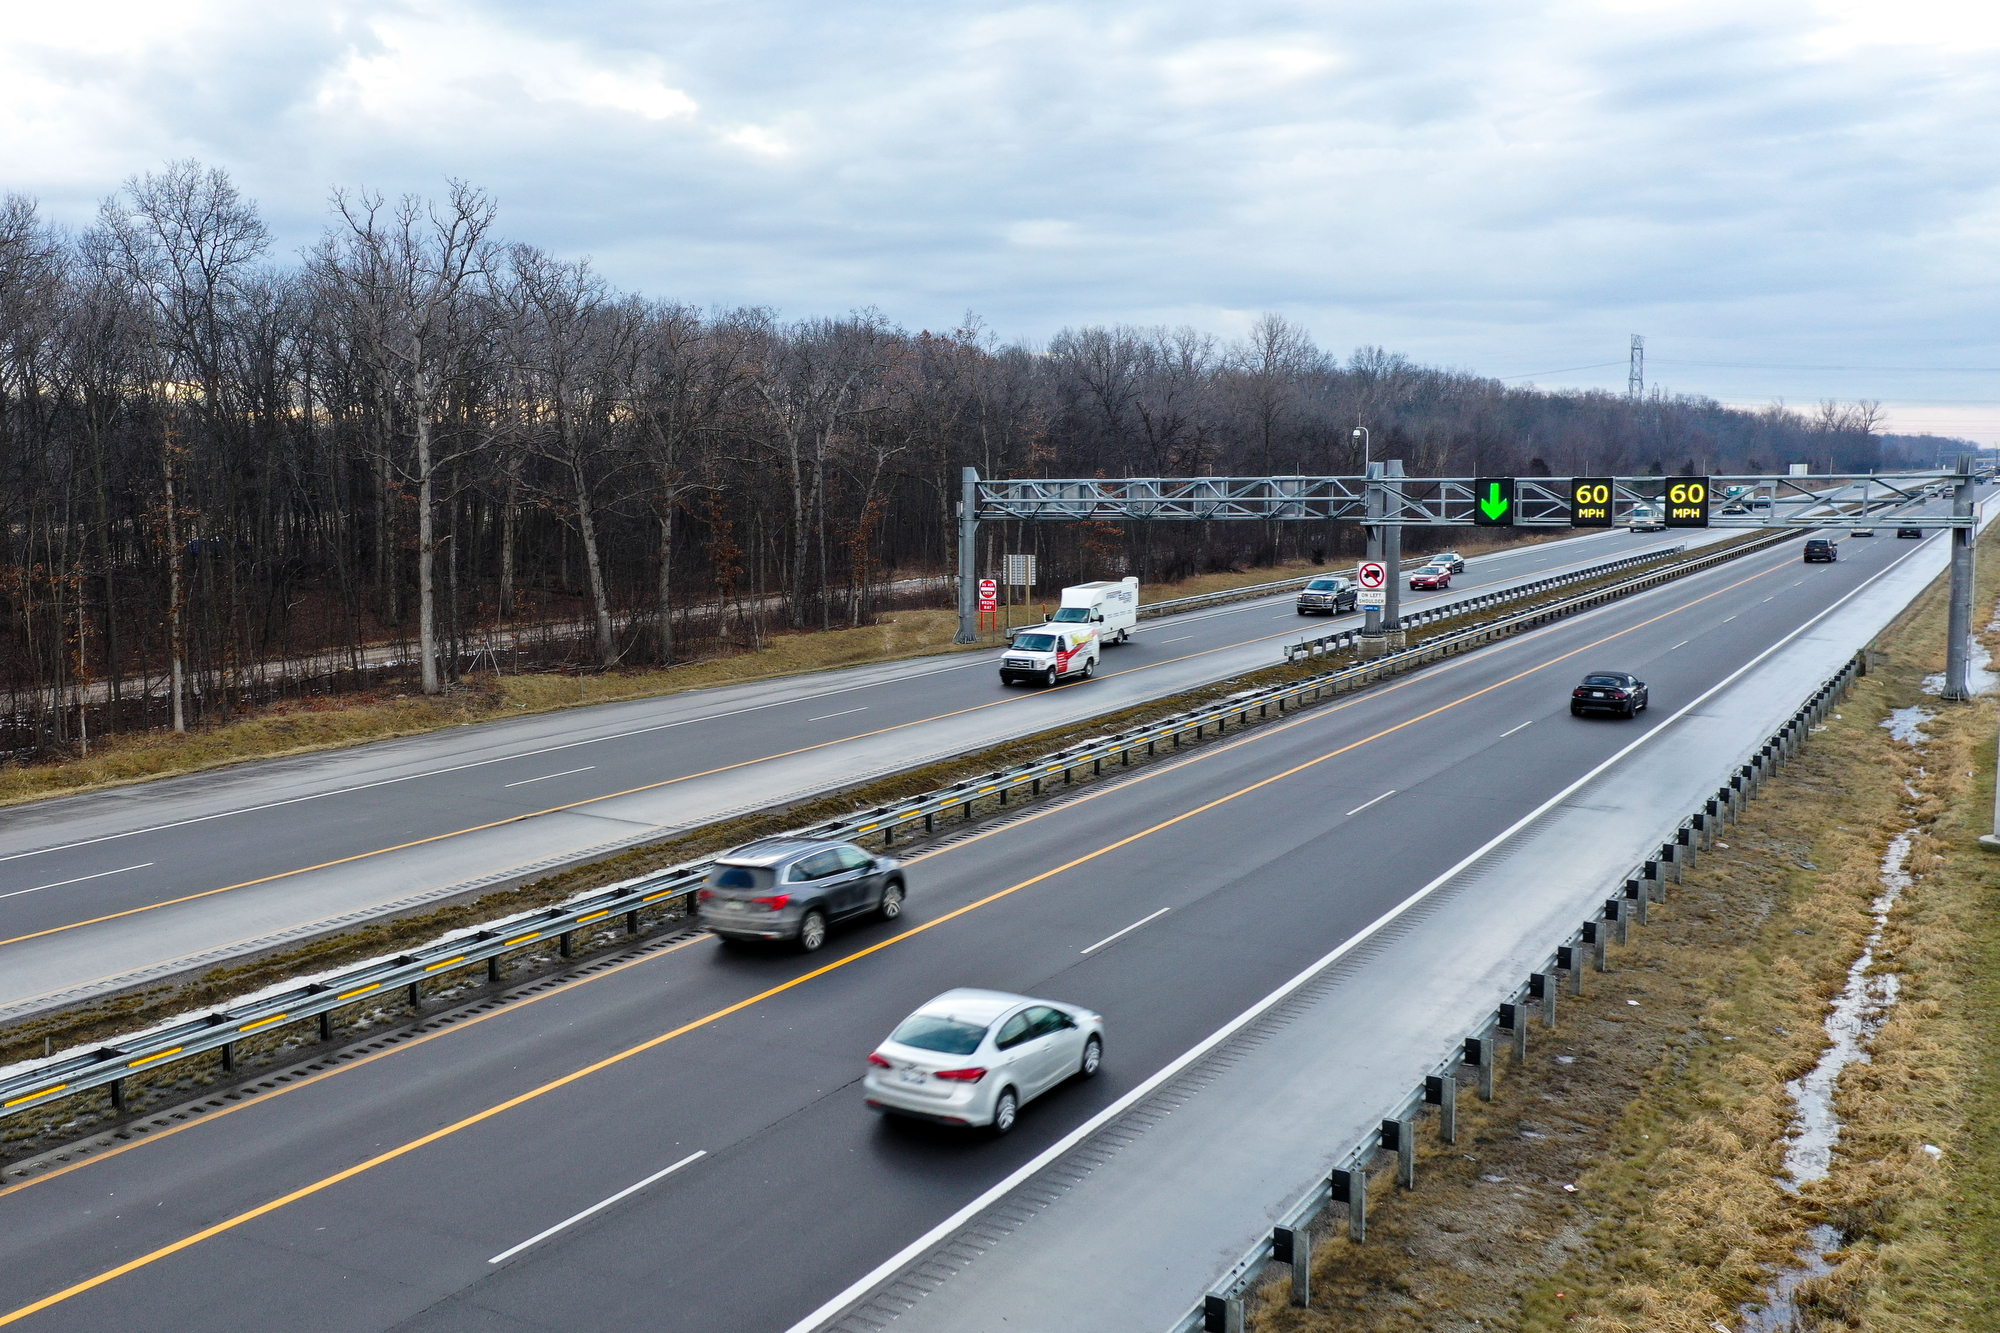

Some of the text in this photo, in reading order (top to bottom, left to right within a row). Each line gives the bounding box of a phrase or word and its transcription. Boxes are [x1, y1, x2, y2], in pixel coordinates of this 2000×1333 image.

[1576, 485, 1608, 504] 60
[1670, 484, 1704, 504] 60
[1578, 508, 1605, 518] MPH
[1672, 508, 1700, 518] MPH
